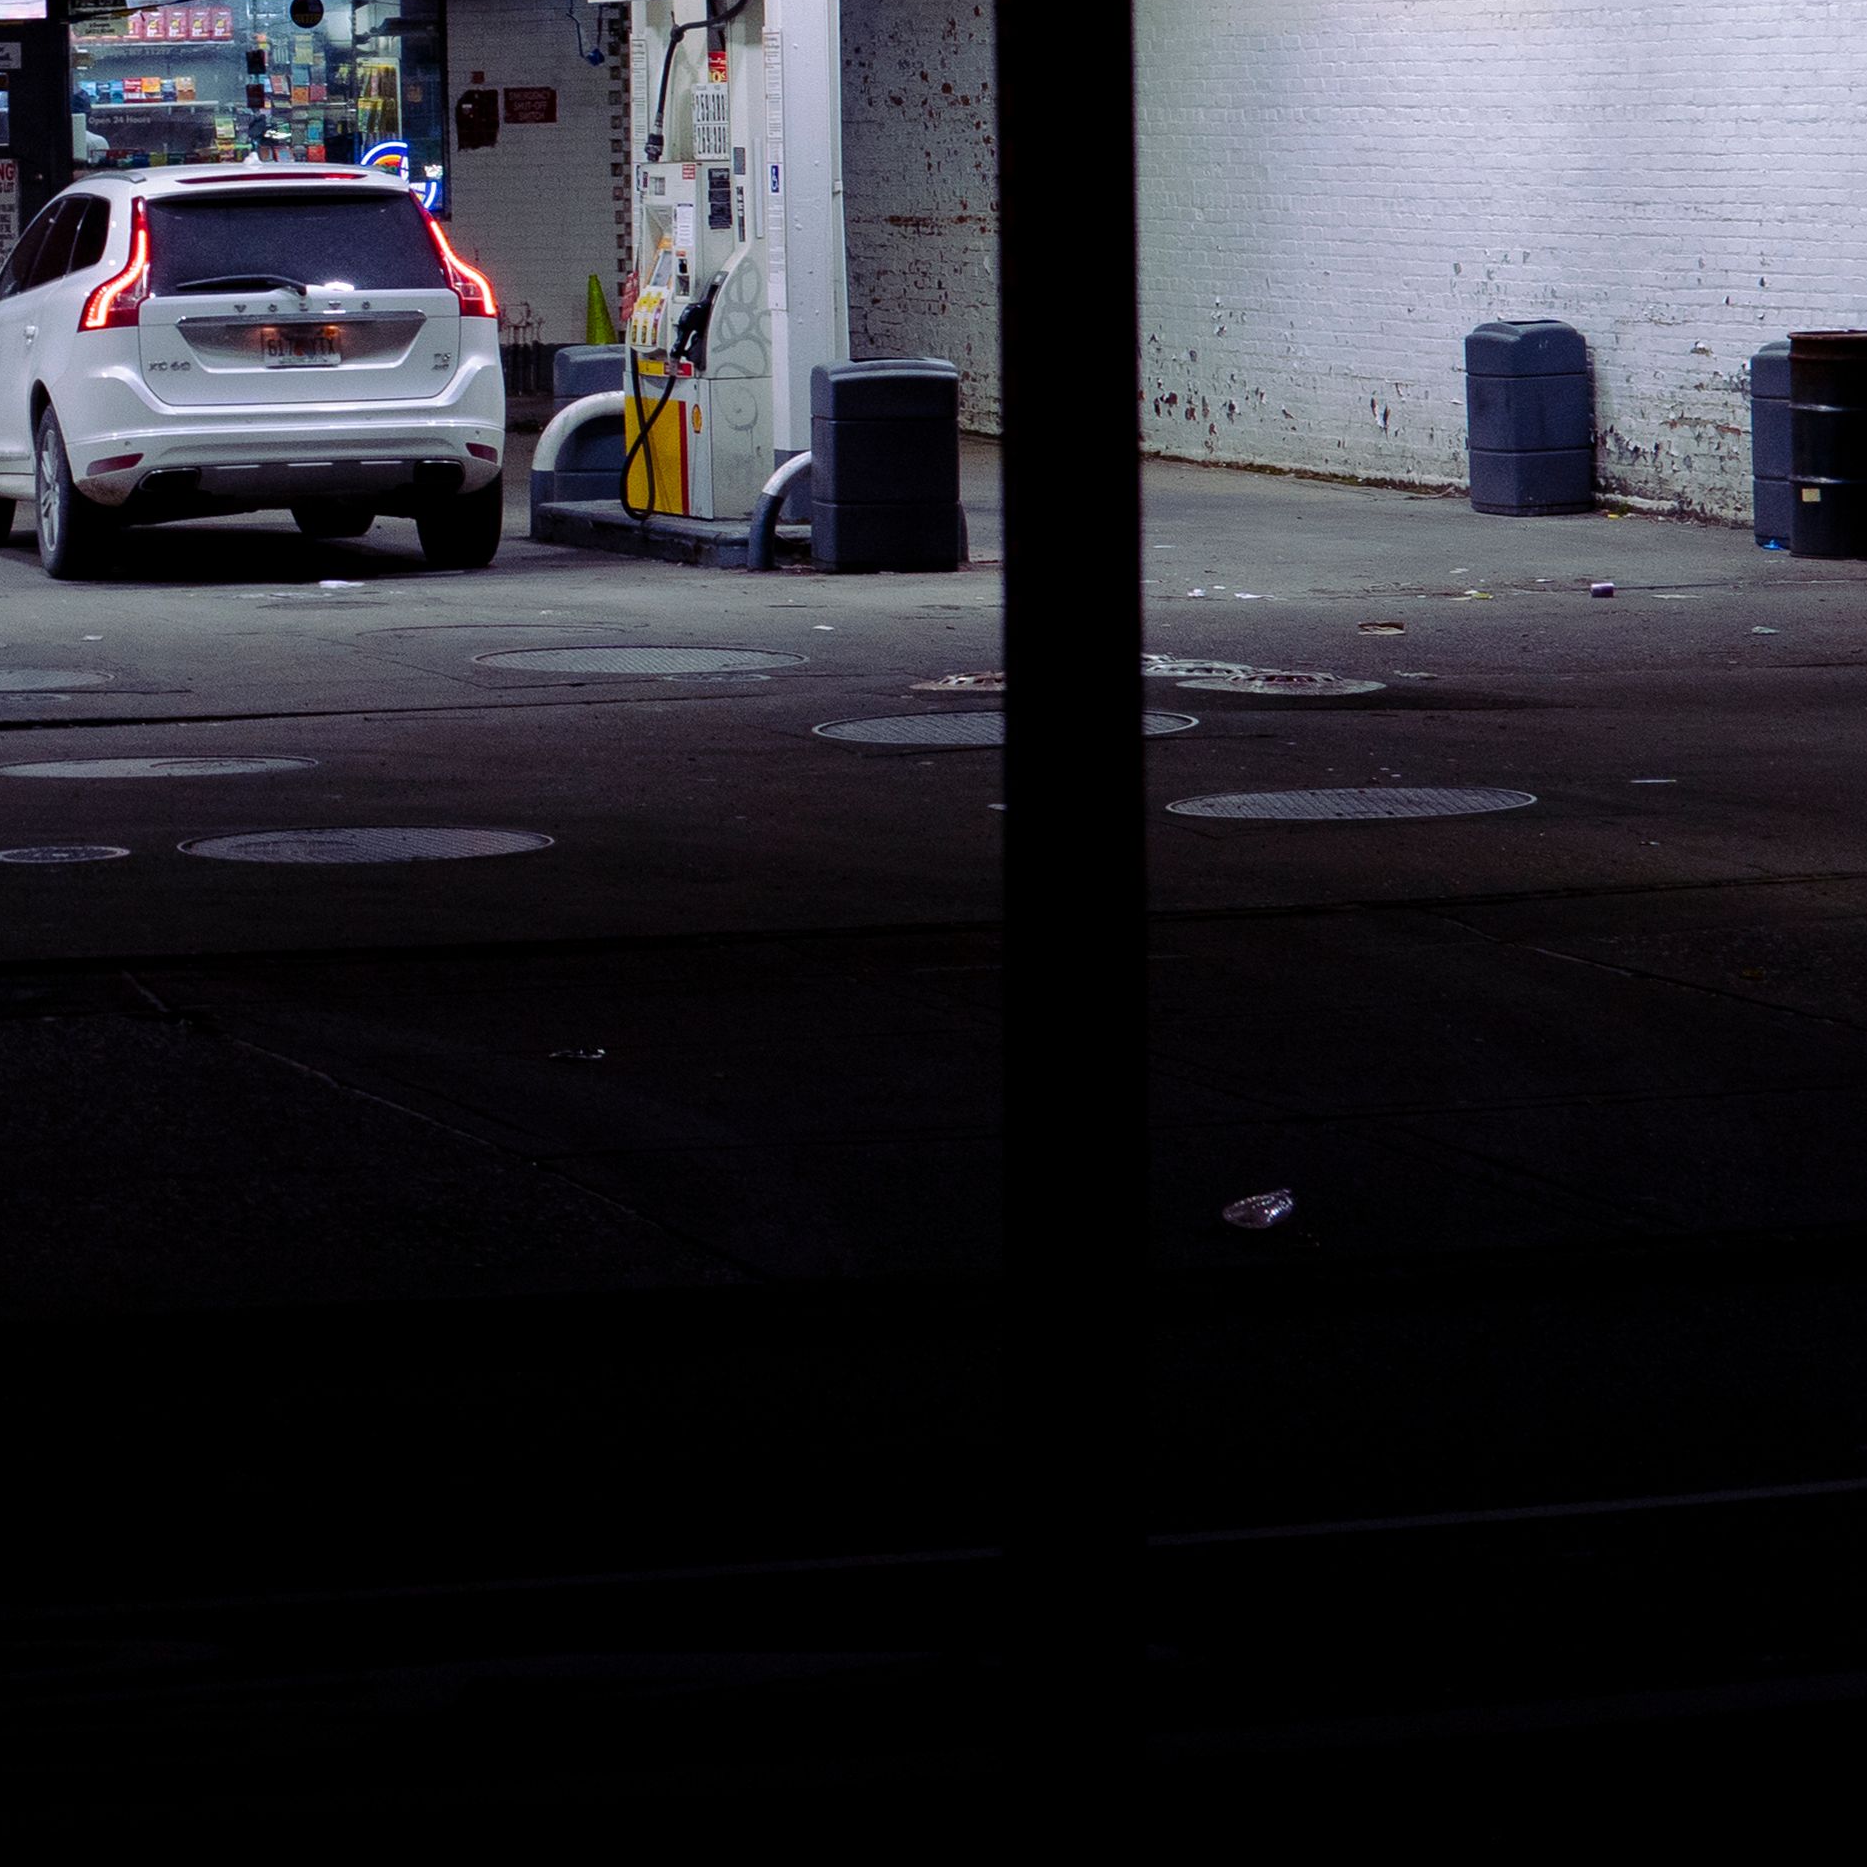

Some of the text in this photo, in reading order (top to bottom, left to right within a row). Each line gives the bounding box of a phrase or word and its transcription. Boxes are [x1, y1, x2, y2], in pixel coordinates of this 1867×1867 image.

[88, 115, 151, 125] Open 24 Hours
[4, 182, 15, 192] LOT
[234, 301, 371, 313] VOLVO
